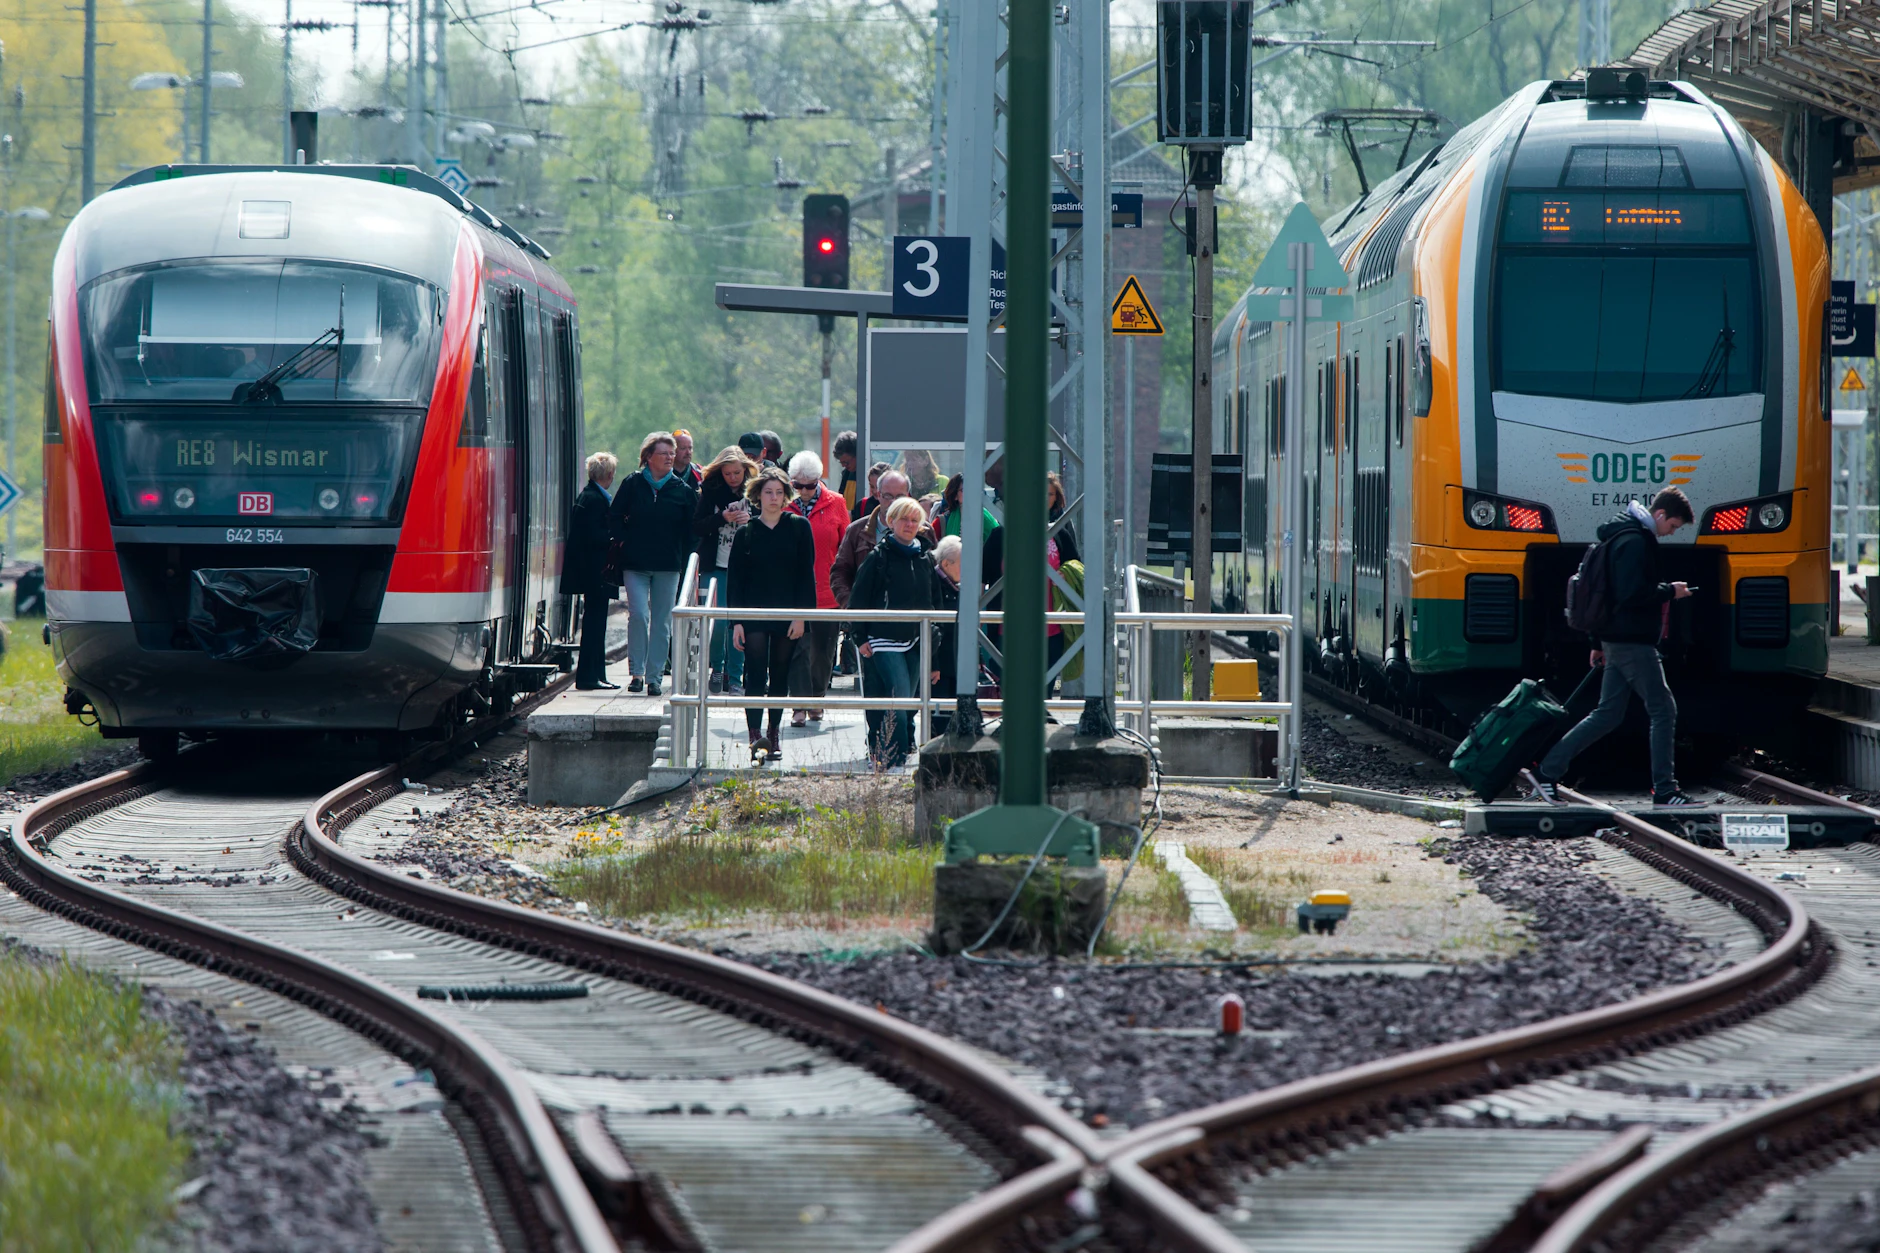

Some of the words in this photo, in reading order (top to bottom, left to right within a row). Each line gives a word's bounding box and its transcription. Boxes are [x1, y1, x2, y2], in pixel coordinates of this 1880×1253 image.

[903, 239, 940, 297] 3
[989, 287, 1007, 297] Ros
[989, 299, 1006, 309] Tes
[177, 439, 216, 466] RE8
[233, 439, 329, 466] Wismar
[1592, 452, 1666, 484] ODEG
[241, 494, 270, 513] DB
[1592, 493, 1608, 506] ET
[226, 528, 253, 543] 642
[257, 529, 284, 543] 554
[1727, 824, 1786, 836] STRAIL
